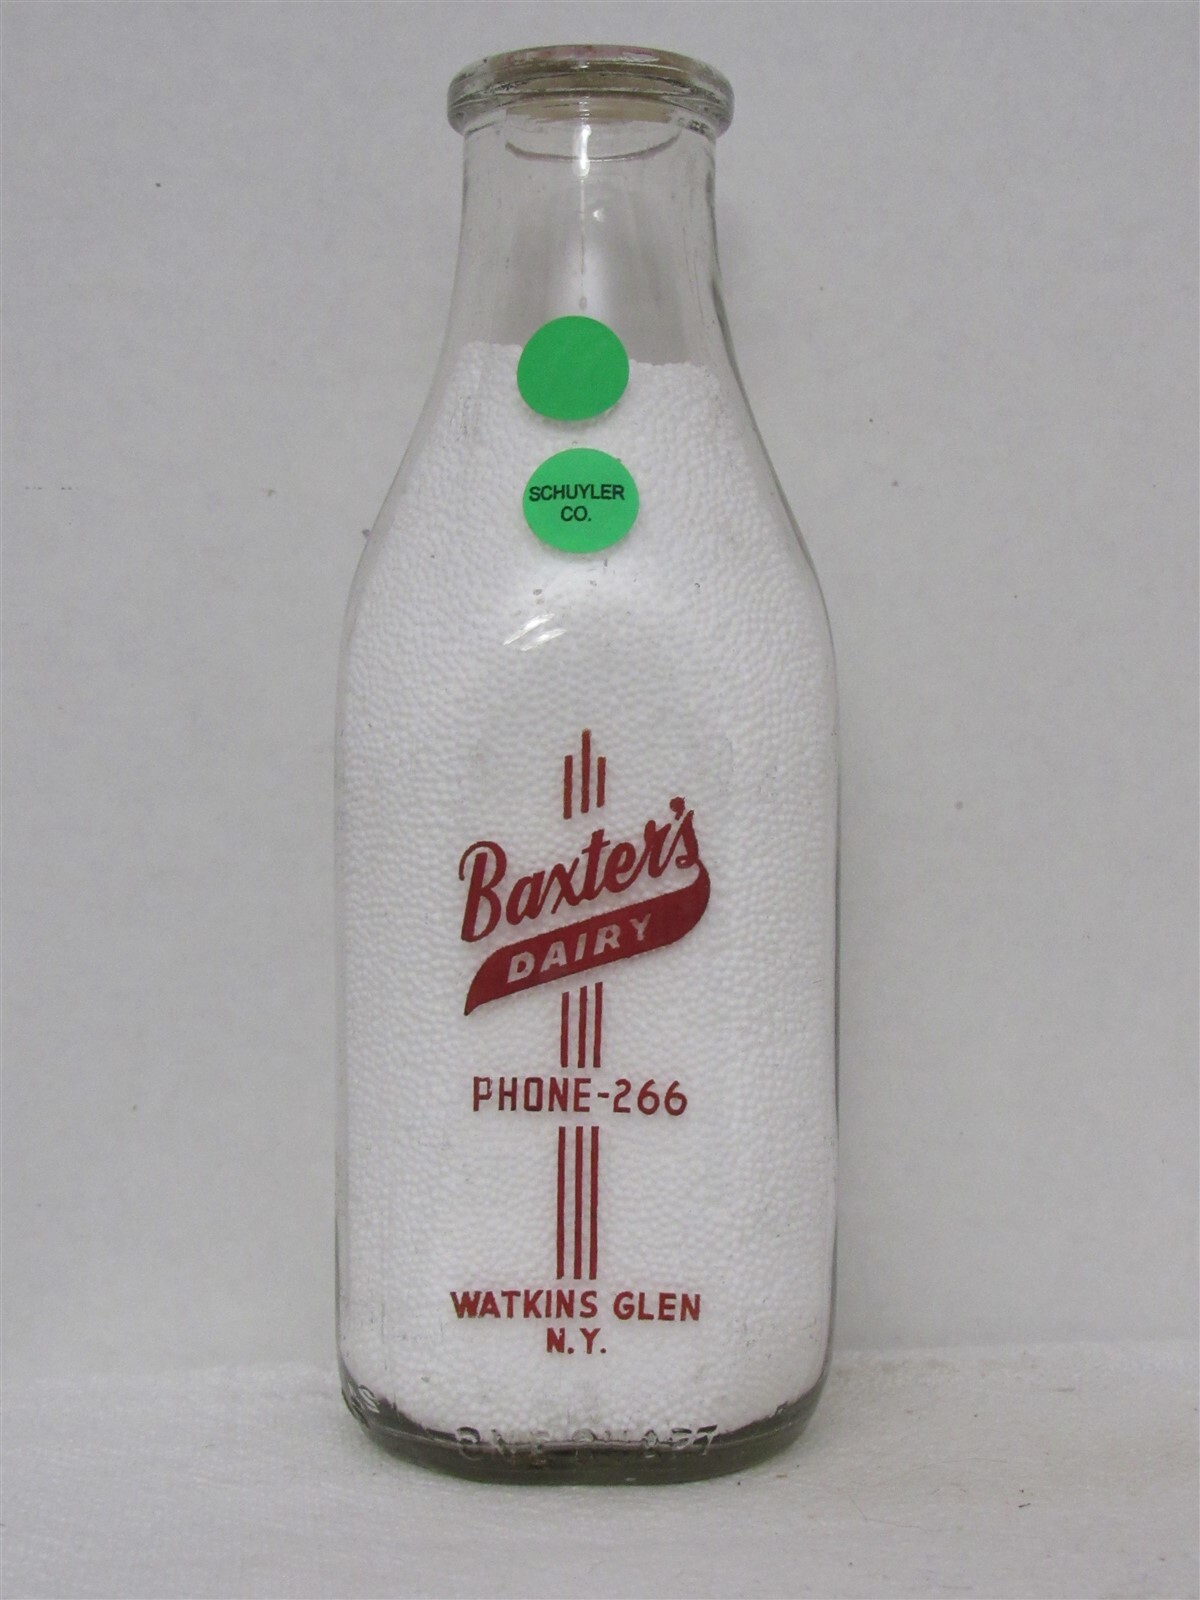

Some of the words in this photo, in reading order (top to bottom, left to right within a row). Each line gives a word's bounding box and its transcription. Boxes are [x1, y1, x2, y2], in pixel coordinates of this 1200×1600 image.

[529, 484, 625, 502] SCHUYLER
[561, 505, 592, 522] CO.
[458, 796, 700, 943] Baxter's
[507, 913, 652, 984] DAIRY
[473, 1076, 688, 1116] PHONE-266
[450, 1289, 598, 1319] WATKINS
[613, 1290, 702, 1321] GLEN
[546, 1326, 607, 1354] N.Y.
